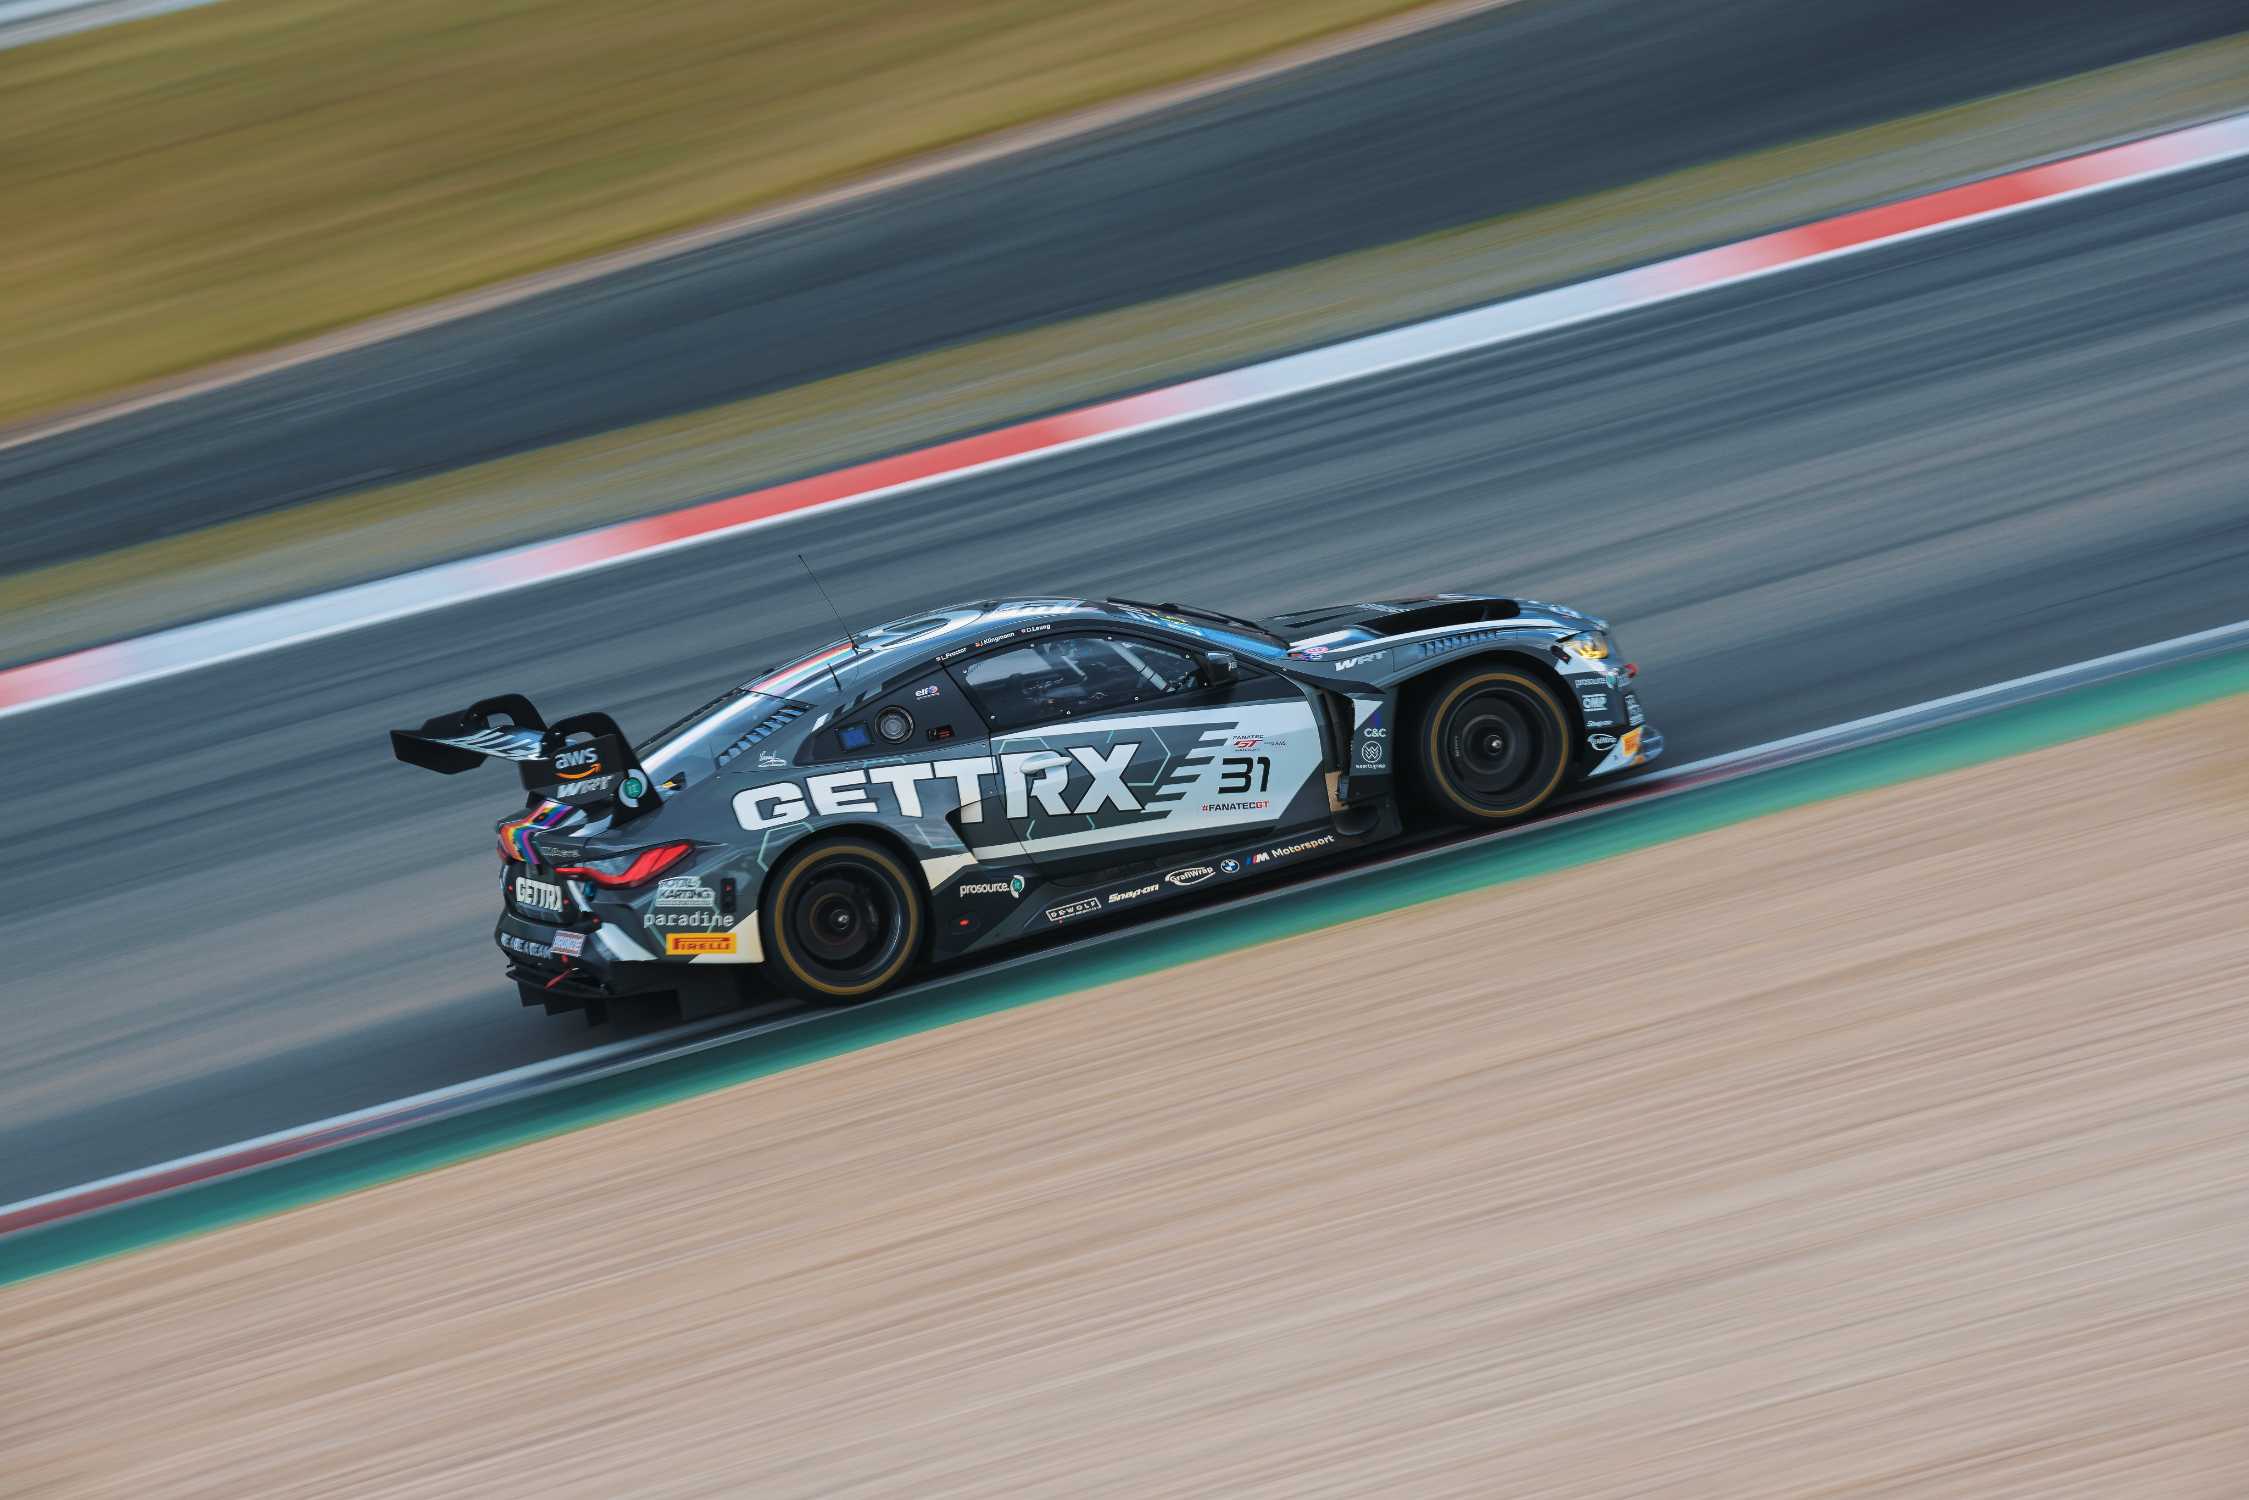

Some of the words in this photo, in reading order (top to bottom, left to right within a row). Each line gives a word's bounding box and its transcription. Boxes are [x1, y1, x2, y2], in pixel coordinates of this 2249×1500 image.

[915, 687, 929, 697] elf
[1363, 727, 1387, 738] C&C
[555, 748, 598, 769] aws
[1218, 756, 1271, 794] 31
[732, 741, 1145, 831] GETTRX
[1201, 800, 1270, 812] #FANATECGT
[1271, 834, 1335, 858] Motorsport
[1108, 884, 1159, 903] Snap-on
[644, 911, 734, 928] paradine
[671, 938, 731, 950] PIRELLI
